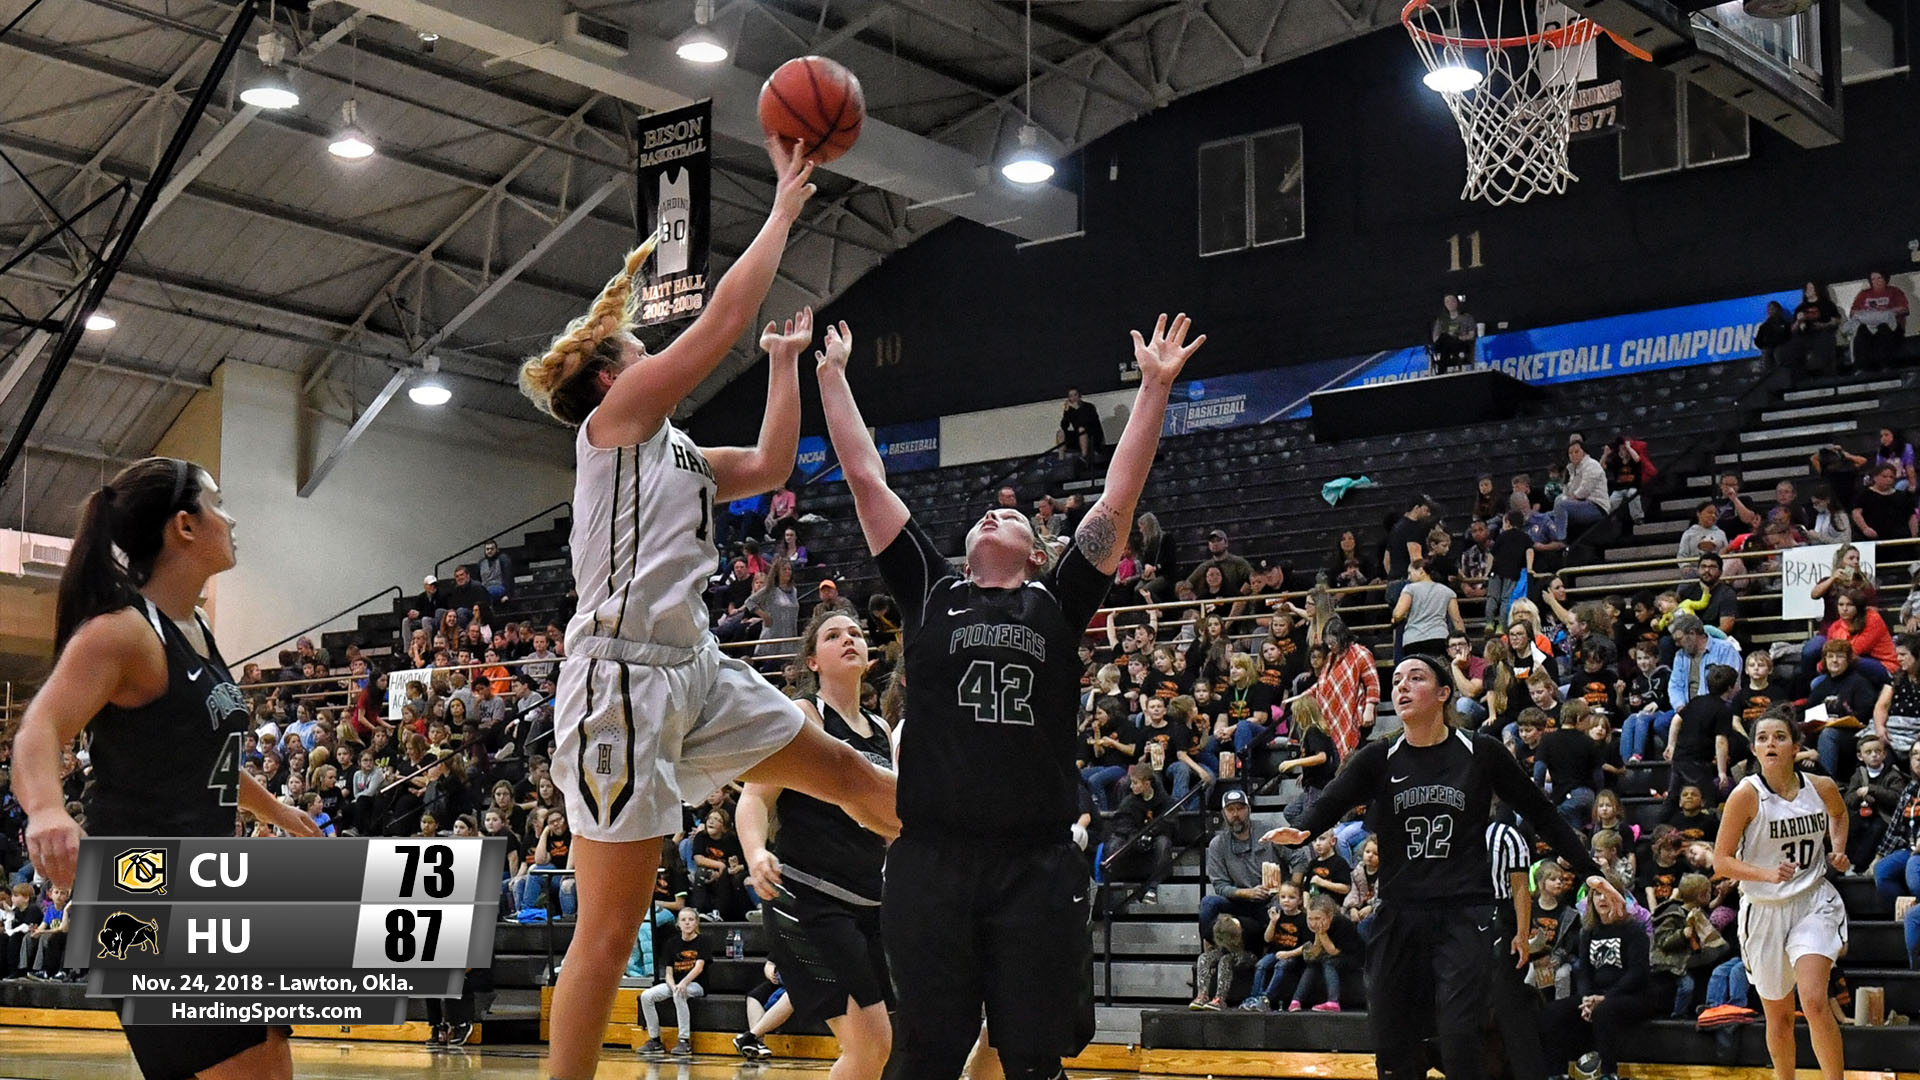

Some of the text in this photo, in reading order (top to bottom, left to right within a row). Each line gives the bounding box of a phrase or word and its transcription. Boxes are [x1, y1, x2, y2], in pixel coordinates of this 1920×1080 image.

[643, 116, 704, 150] BISON
[640, 138, 707, 168] BASKETBALL
[1446, 230, 1485, 272] 11
[642, 274, 706, 301] MATT HALL
[1188, 400, 1246, 420] BASKETBALL
[798, 450, 826, 465] NCAA
[889, 438, 937, 455] BASKETBALL
[950, 624, 1046, 662] PIONEERS
[958, 660, 1034, 726] 42
[1394, 785, 1466, 814] PIONEERS
[1405, 814, 1453, 860] 32
[1769, 813, 1826, 839] HARDING
[1781, 839, 1815, 870] 30
